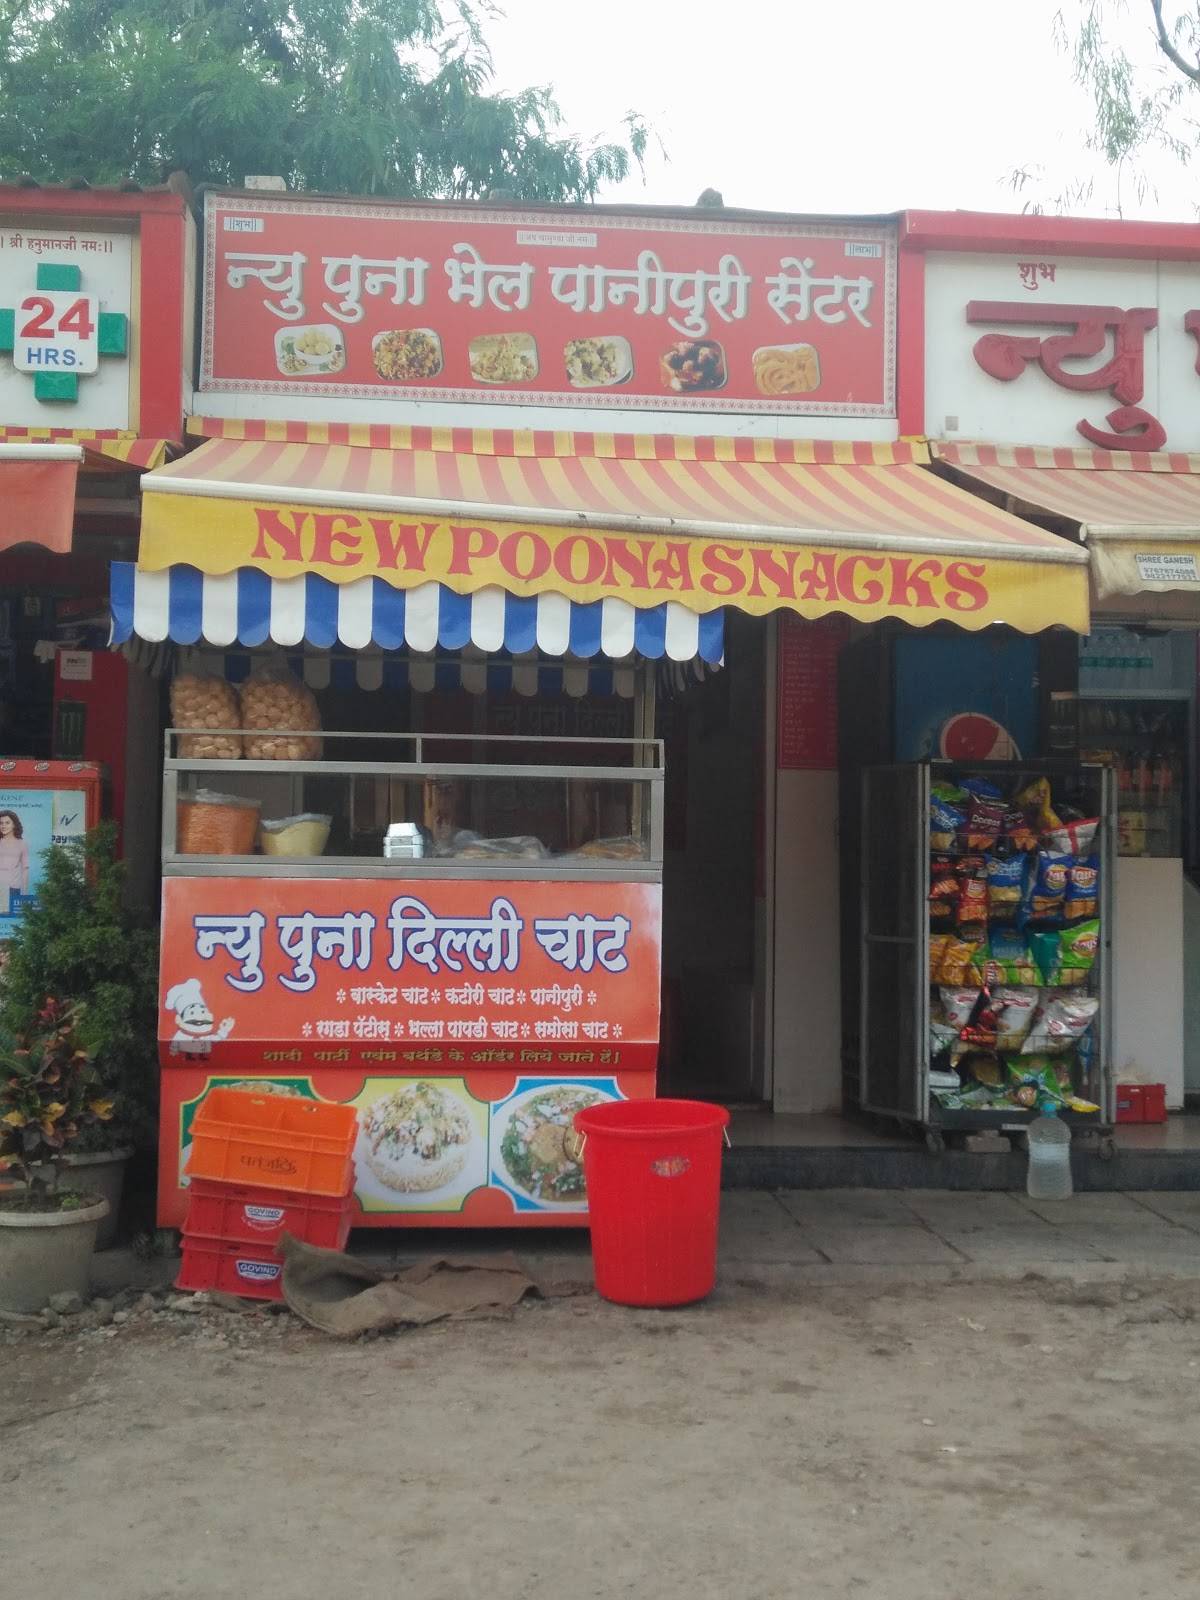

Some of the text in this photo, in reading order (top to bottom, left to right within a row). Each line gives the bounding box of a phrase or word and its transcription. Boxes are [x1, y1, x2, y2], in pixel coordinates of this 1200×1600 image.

[26, 235, 77, 254] हनुमानजी
[224, 242, 874, 338] न्यु पुना भेल पानीपुरी सेंटर
[1018, 262, 1057, 291] शुभ
[20, 296, 94, 340] 24
[27, 347, 83, 366] HRS.
[966, 300, 1168, 453] न्यु
[251, 507, 989, 611] NEW POONA SNACKS
[192, 895, 632, 993] न्यु पुना दिल्ली चाट
[350, 982, 583, 1012] बास्केट चाट कटोरी चाट पानीपुरी
[316, 1020, 350, 1038] रगडा
[408, 1020, 444, 1038] भल्ला
[447, 1016, 488, 1038] पापडी
[491, 1020, 519, 1038] चाट
[534, 1016, 579, 1039] समोसा
[581, 1021, 609, 1039] चाट
[240, 1263, 277, 1274] GOVIND
